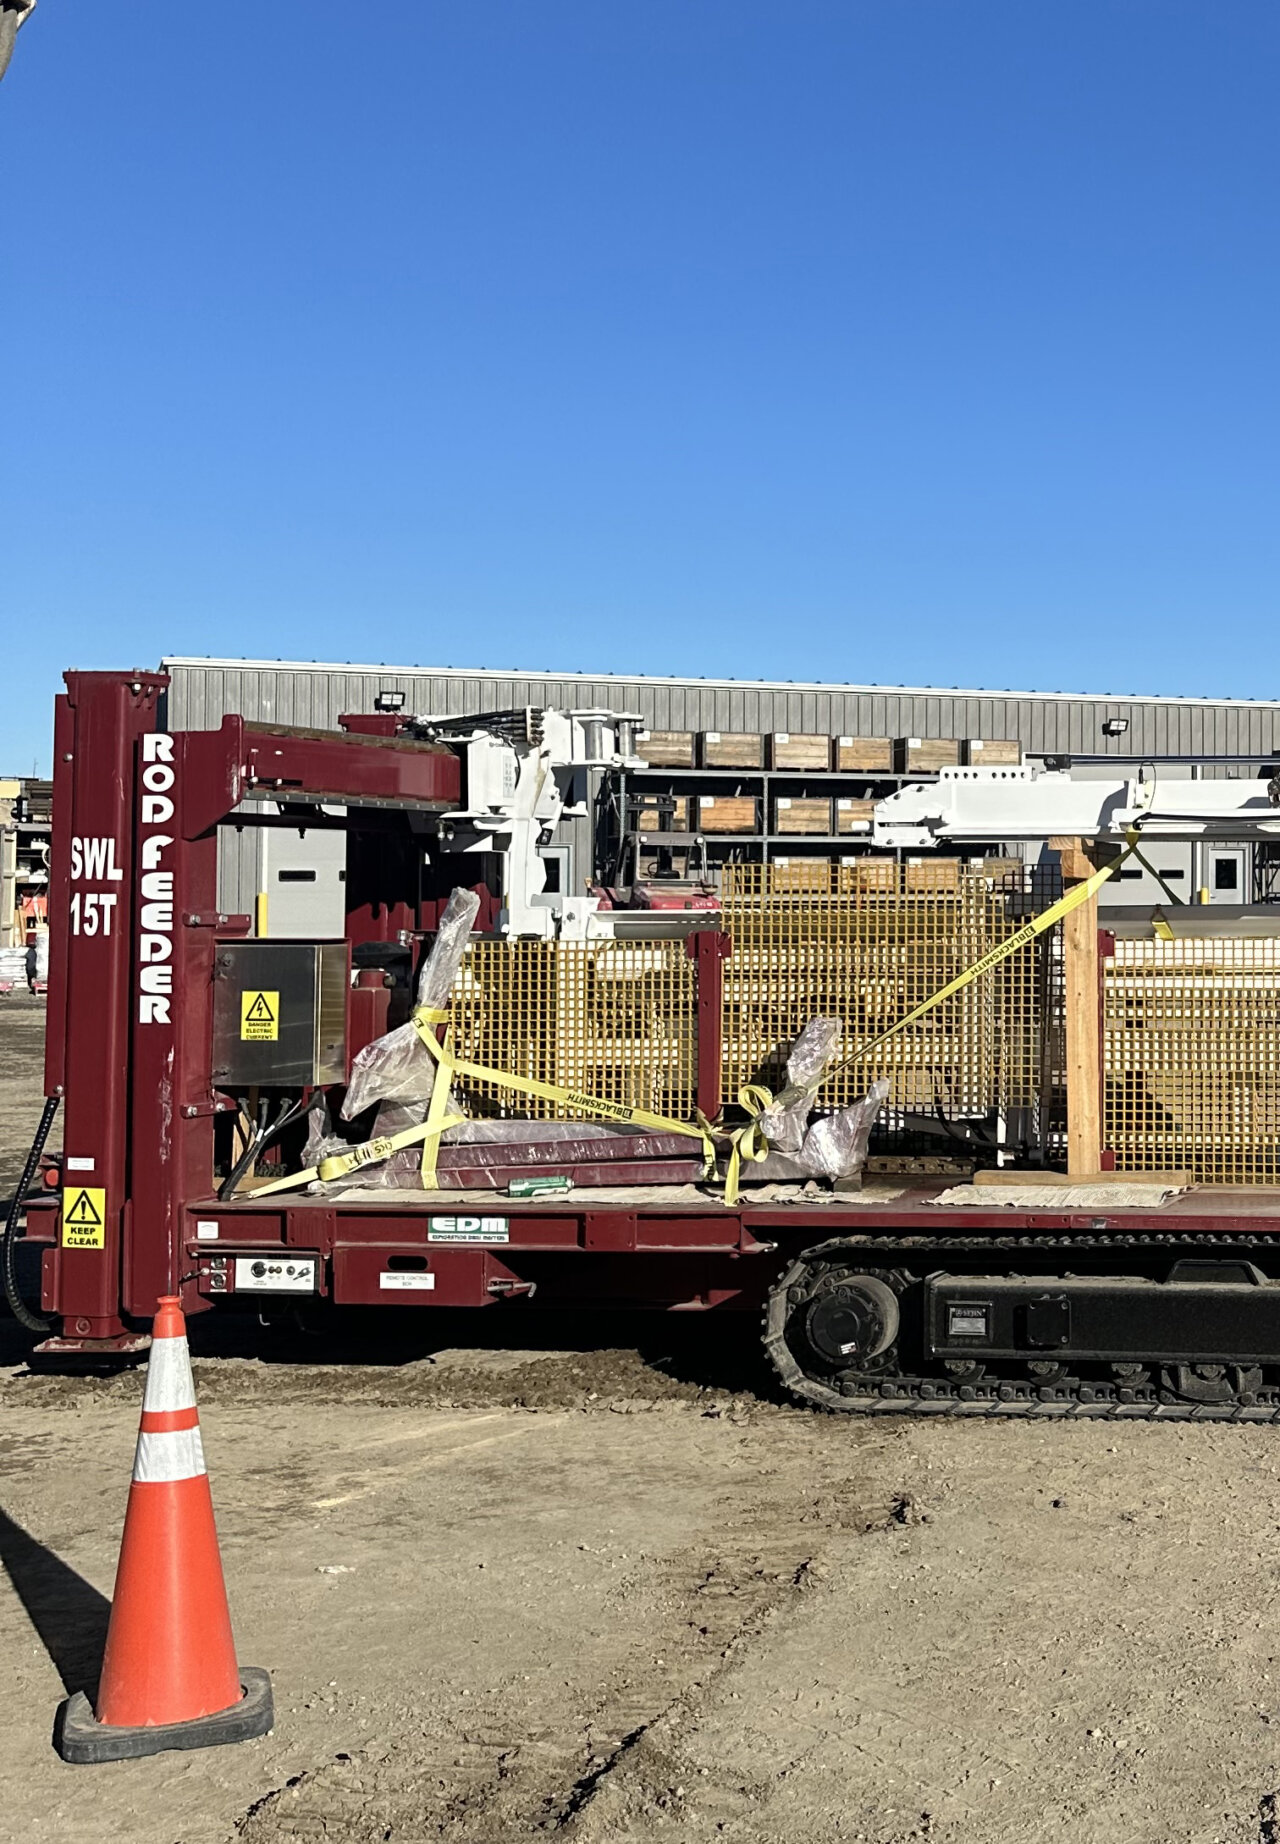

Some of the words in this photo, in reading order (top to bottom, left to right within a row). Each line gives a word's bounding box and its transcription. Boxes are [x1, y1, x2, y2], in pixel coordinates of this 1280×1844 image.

[142, 733, 175, 823] ROD
[71, 836, 123, 881] SWL
[70, 892, 117, 936] 15T
[139, 835, 175, 1024] FEEDER
[970, 933, 1027, 976] BLACKSMITH
[567, 1093, 624, 1116] BLACKSMITH
[67, 1237, 99, 1246] CLEAR
[70, 1227, 96, 1235] KEEP
[432, 1217, 506, 1232] EDM
